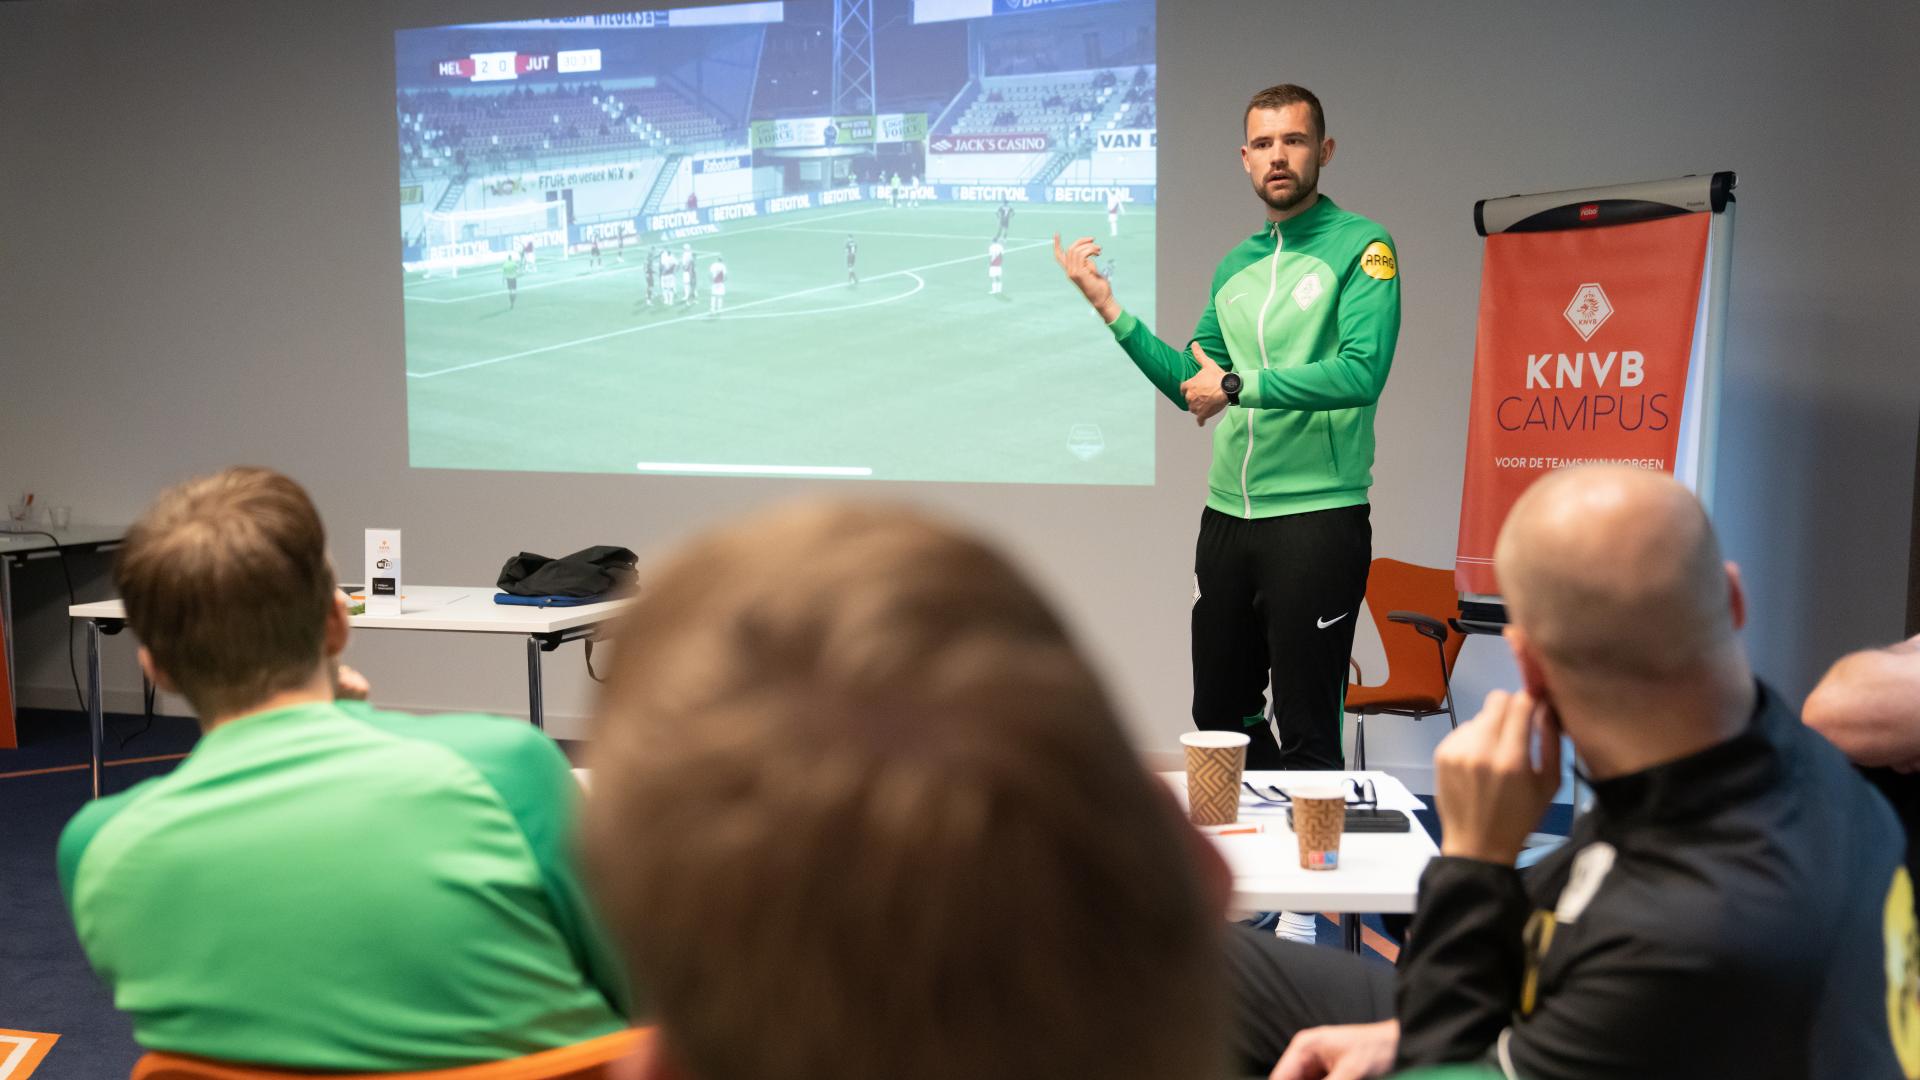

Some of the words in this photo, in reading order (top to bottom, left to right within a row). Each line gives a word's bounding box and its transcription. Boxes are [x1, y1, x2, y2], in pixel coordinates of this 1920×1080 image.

[439, 62, 463, 76] HEL
[481, 61, 488, 73] 2
[499, 60, 507, 72] 0
[525, 56, 550, 71] JUT
[953, 139, 996, 151] JACK'S
[998, 137, 1046, 150] CASINO
[1100, 134, 1141, 148] VAN
[1365, 254, 1395, 269] ARAG
[1526, 351, 1645, 389] KNVB
[1497, 394, 1669, 431] CAMPUS
[1495, 457, 1526, 469] VOOR
[1529, 457, 1543, 469] DE
[1545, 458, 1582, 469] TEAMS
